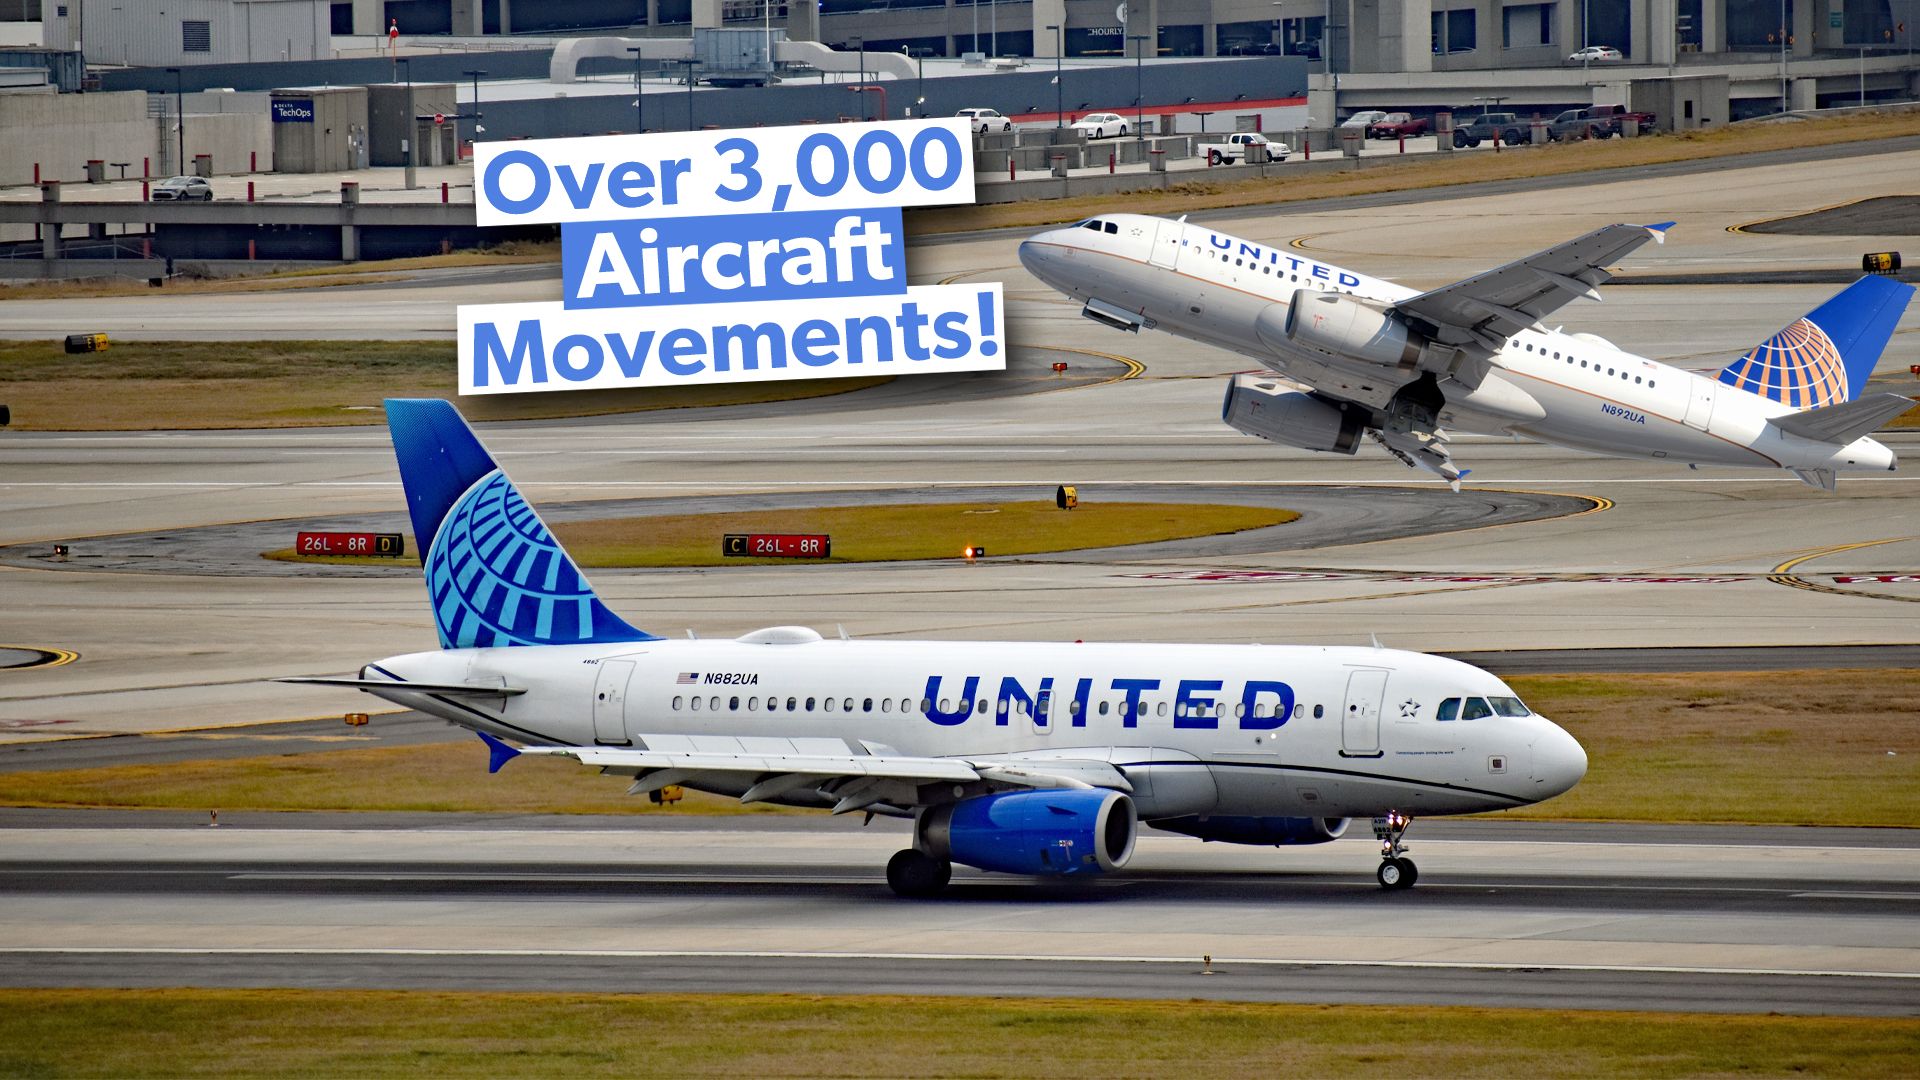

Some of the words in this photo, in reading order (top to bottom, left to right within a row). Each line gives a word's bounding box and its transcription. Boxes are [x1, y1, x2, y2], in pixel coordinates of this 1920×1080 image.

[1091, 27, 1123, 36] HOURLY
[278, 108, 311, 118] TechOps
[1210, 234, 1360, 287] UNITED
[1601, 403, 1645, 425] N892UA
[304, 536, 331, 551] 26L
[348, 537, 366, 551] 8R
[381, 537, 390, 551] D
[731, 538, 740, 552] C
[756, 539, 783, 553] 26L
[800, 539, 819, 553] 8R
[704, 672, 758, 685] N882UA
[924, 675, 1295, 731] UNITED
